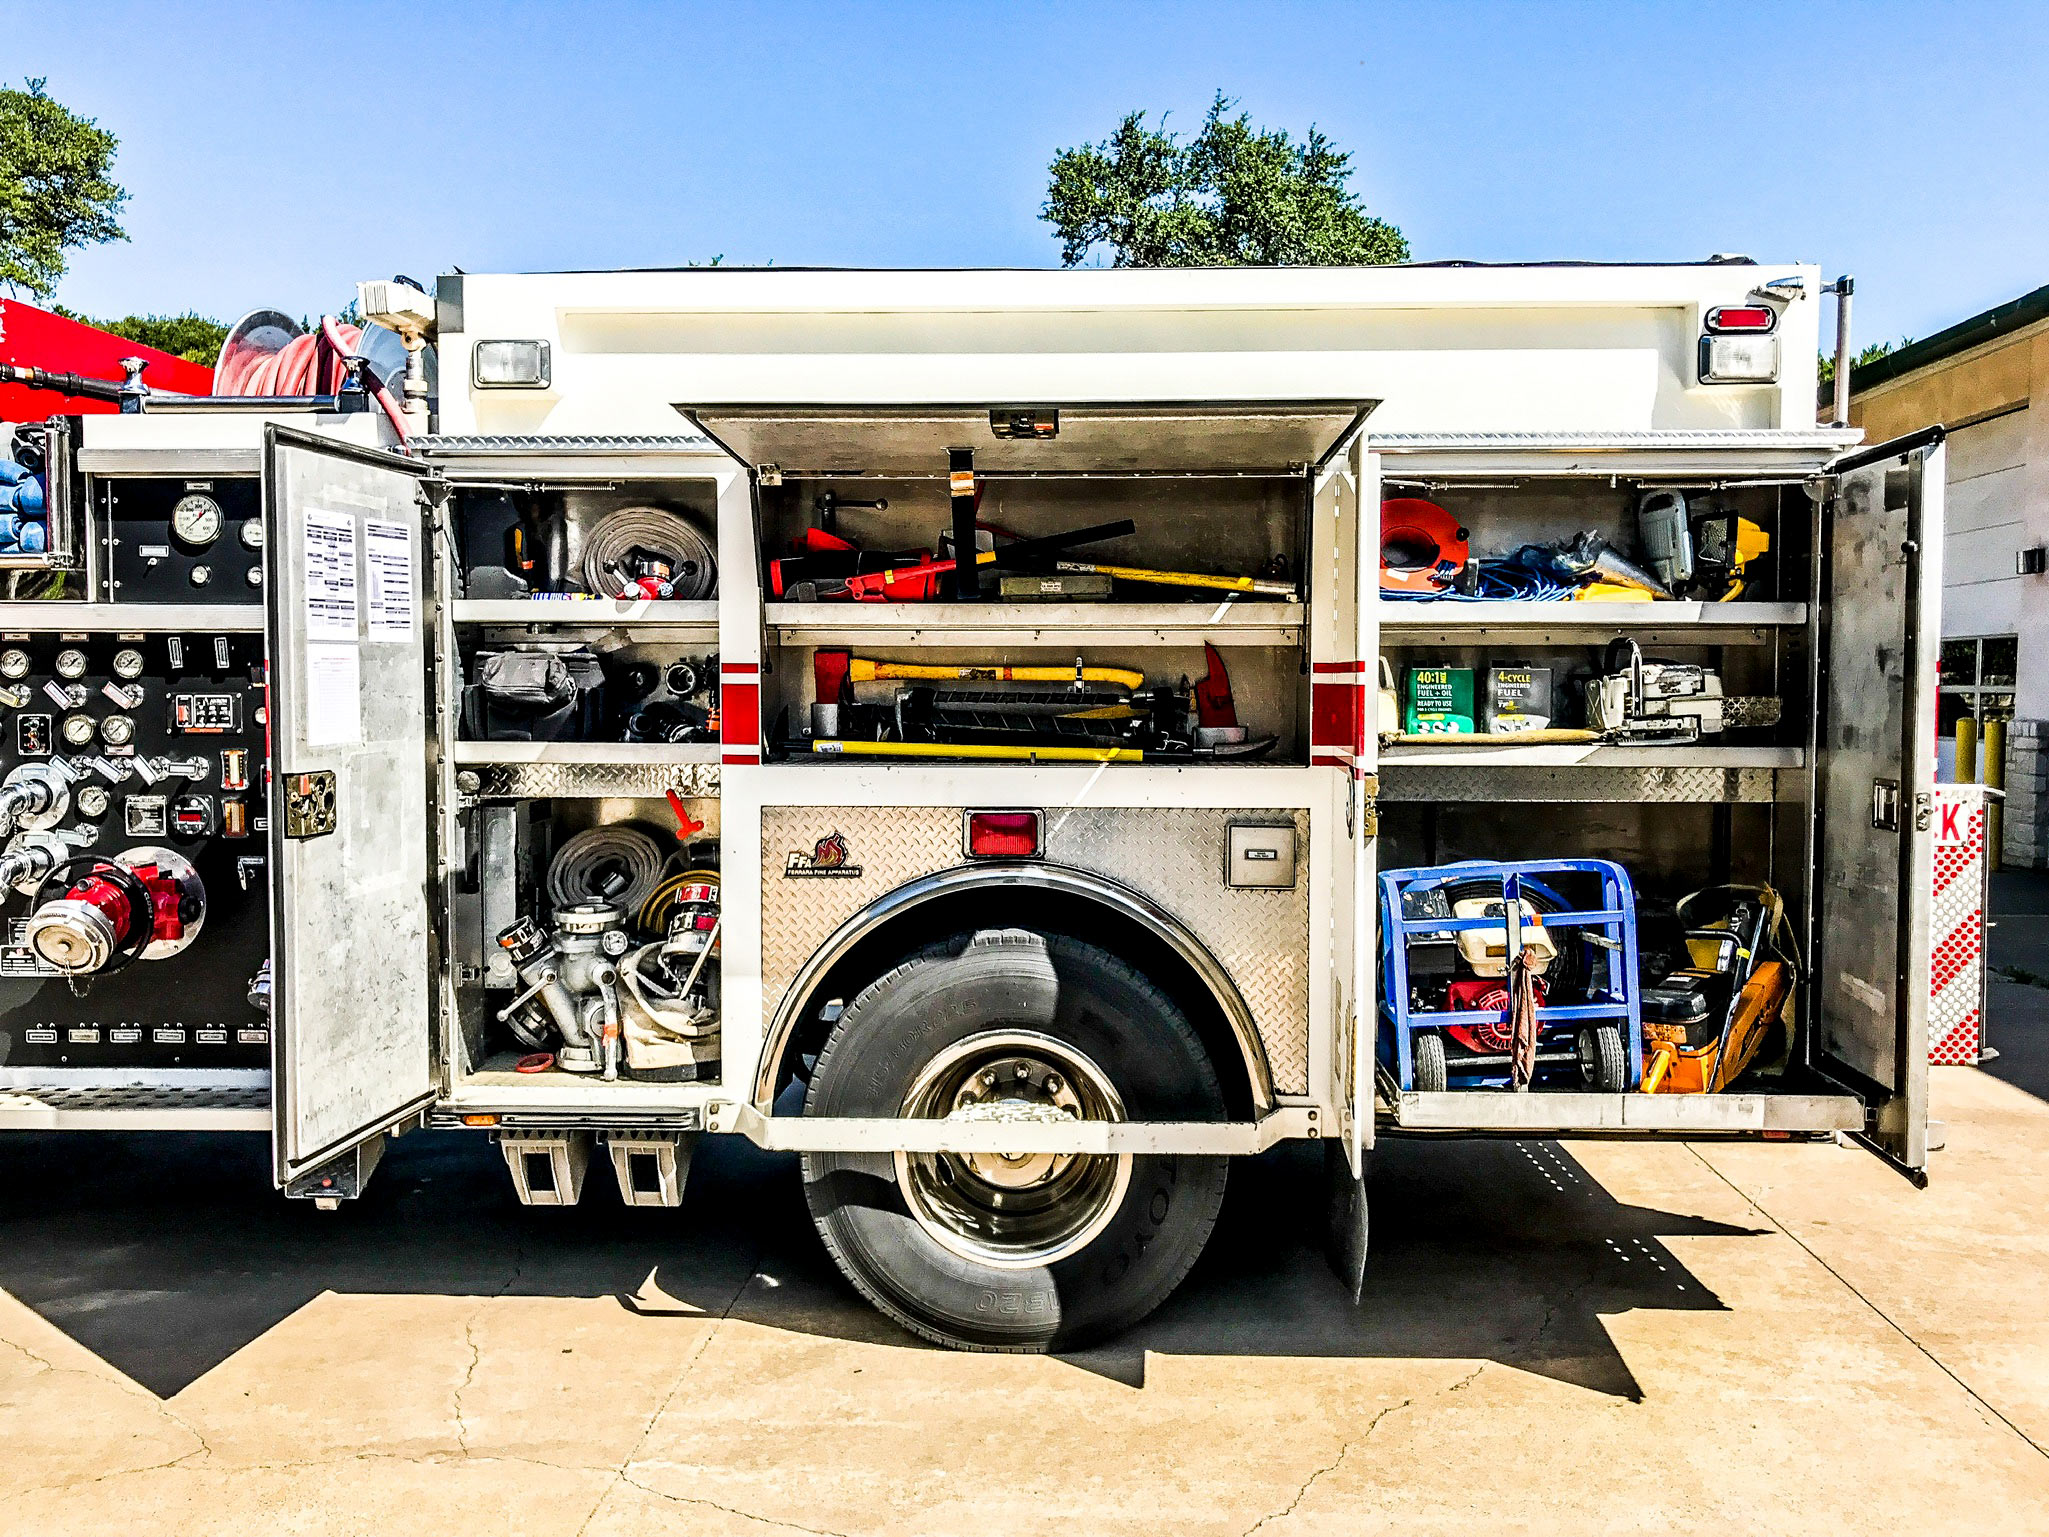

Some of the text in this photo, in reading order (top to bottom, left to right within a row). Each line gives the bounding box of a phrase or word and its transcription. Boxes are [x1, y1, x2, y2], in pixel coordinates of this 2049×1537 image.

[1417, 671, 1439, 684] 40:1
[1498, 671, 1531, 683] 4-CYCLE
[1497, 689, 1524, 697] FUEL
[787, 853, 812, 869] FFA
